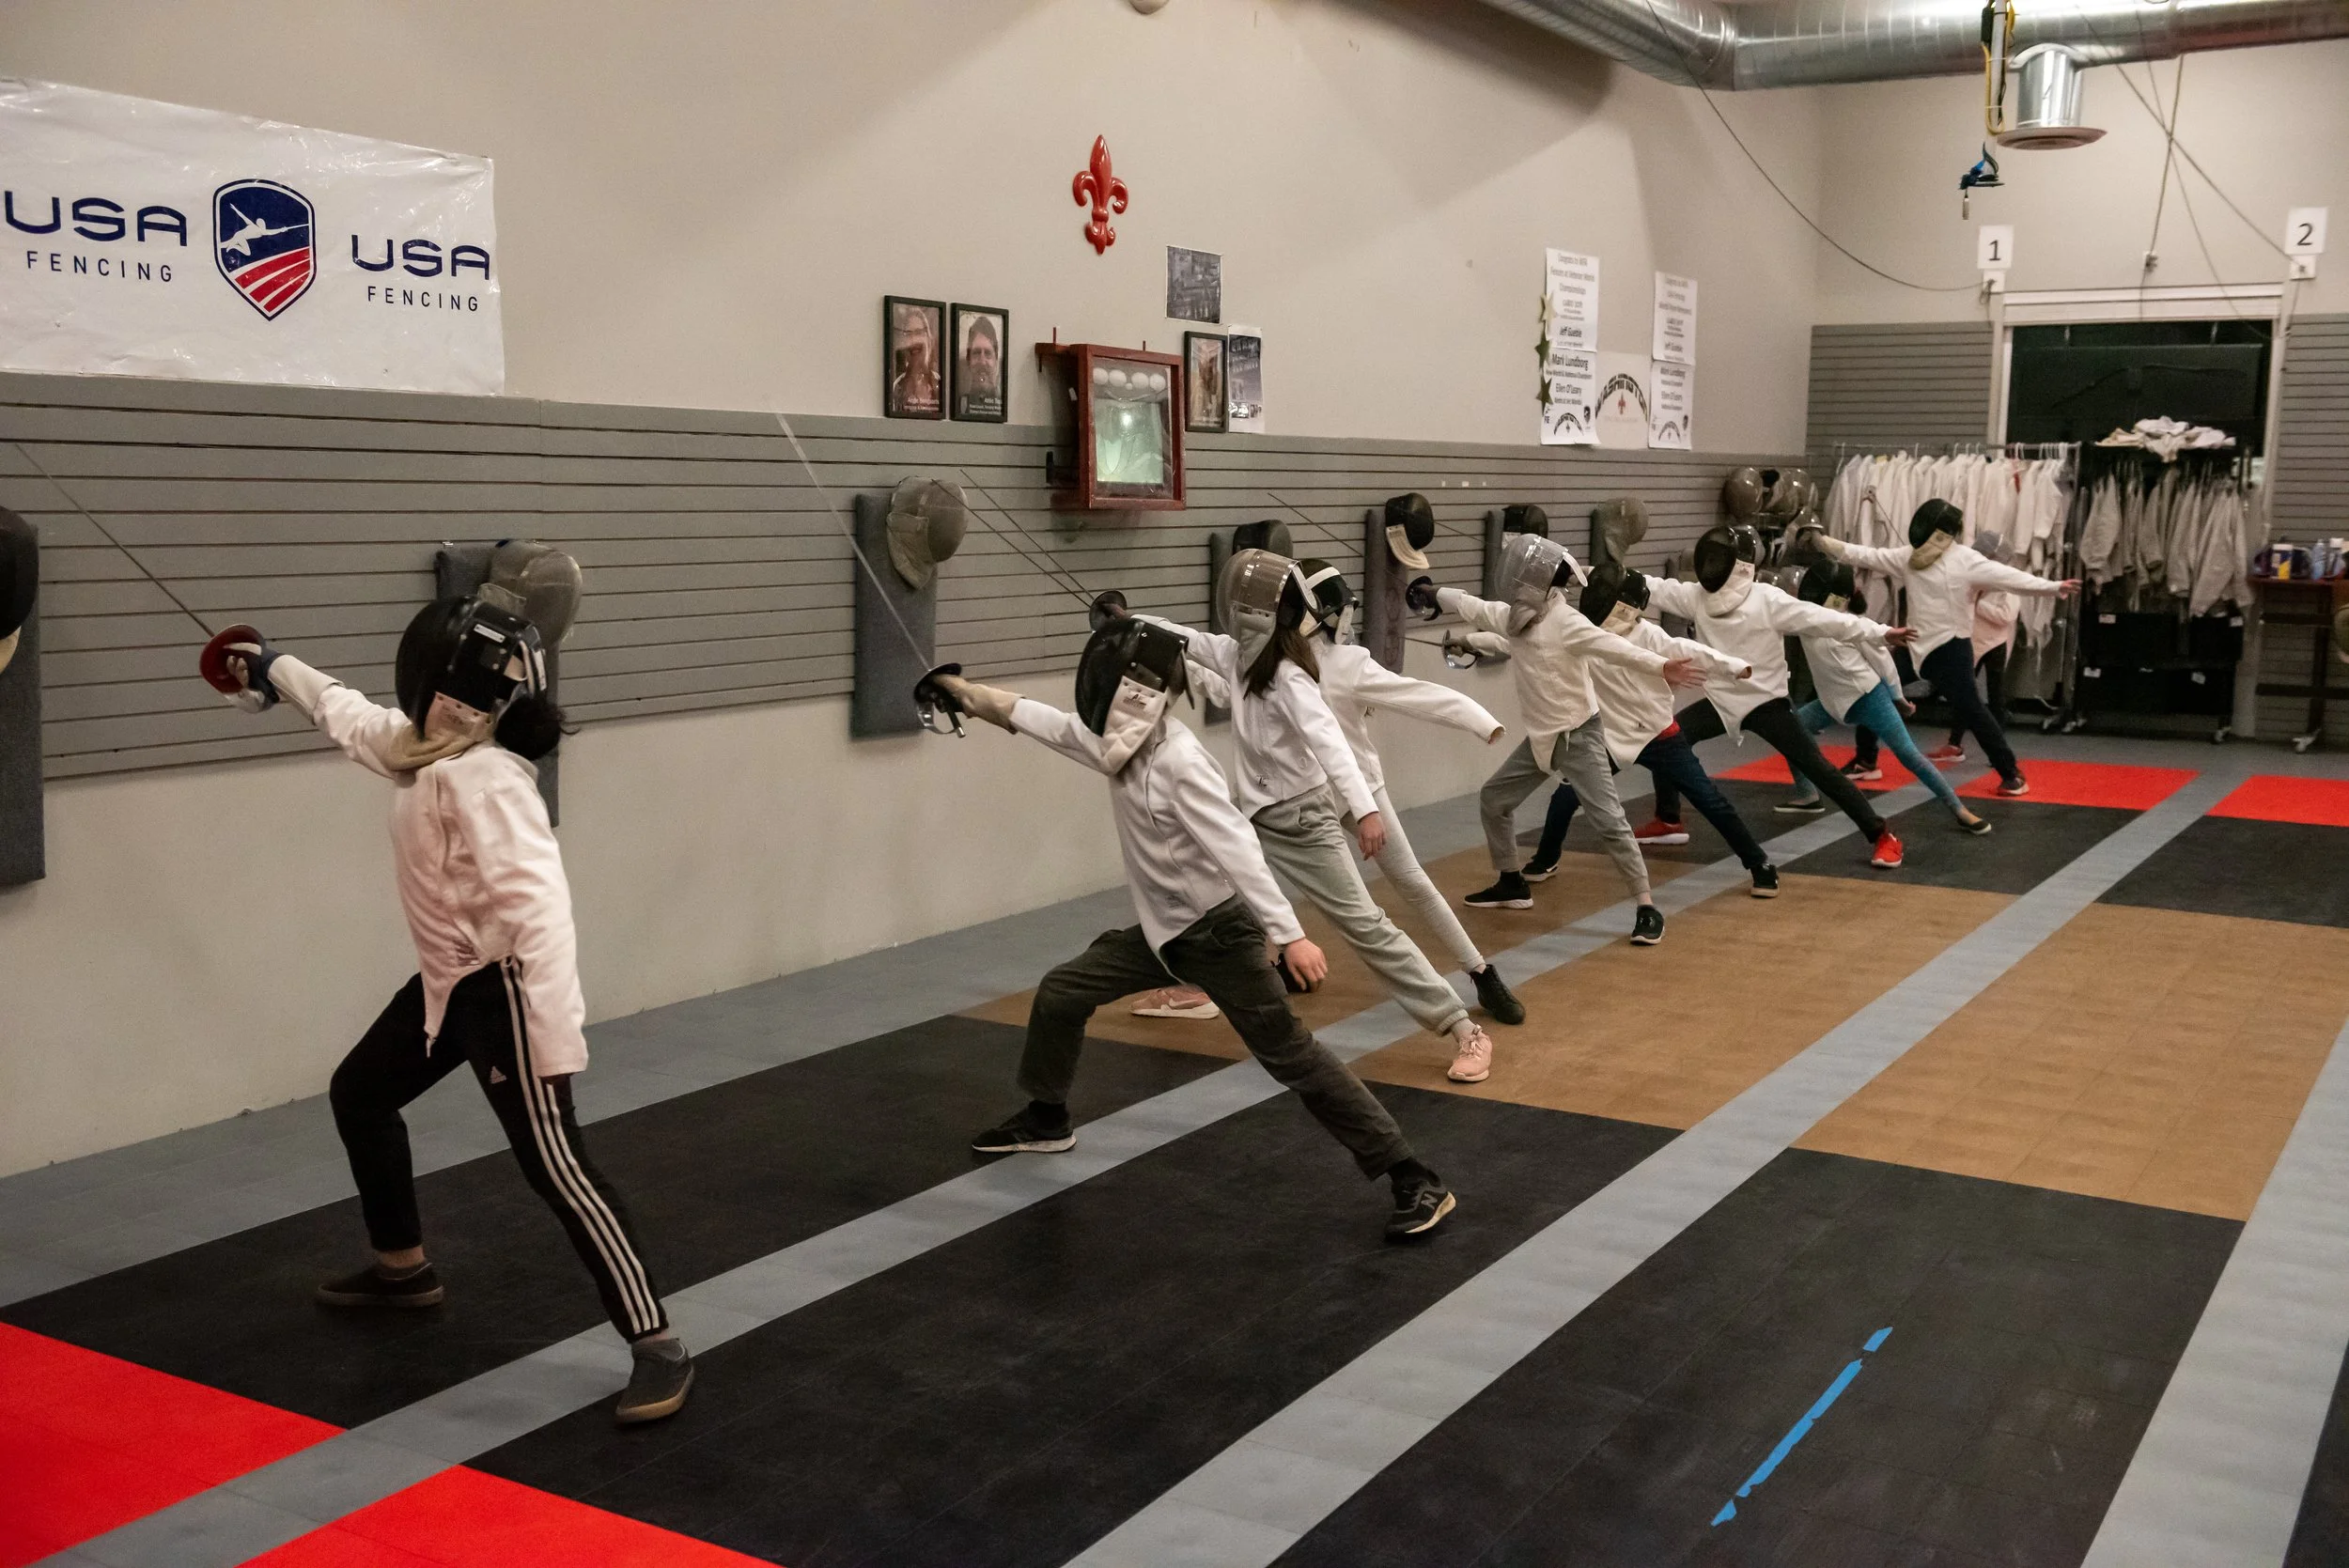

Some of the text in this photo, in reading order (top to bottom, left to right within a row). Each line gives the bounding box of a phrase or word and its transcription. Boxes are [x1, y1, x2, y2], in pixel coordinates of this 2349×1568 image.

[4, 191, 188, 247] USA
[2297, 223, 2313, 246] 2
[351, 234, 490, 281] USA
[1988, 240, 2001, 261] 1
[26, 251, 173, 283] FENCING
[367, 286, 479, 312] FENCING
[1552, 353, 1564, 365] Mark
